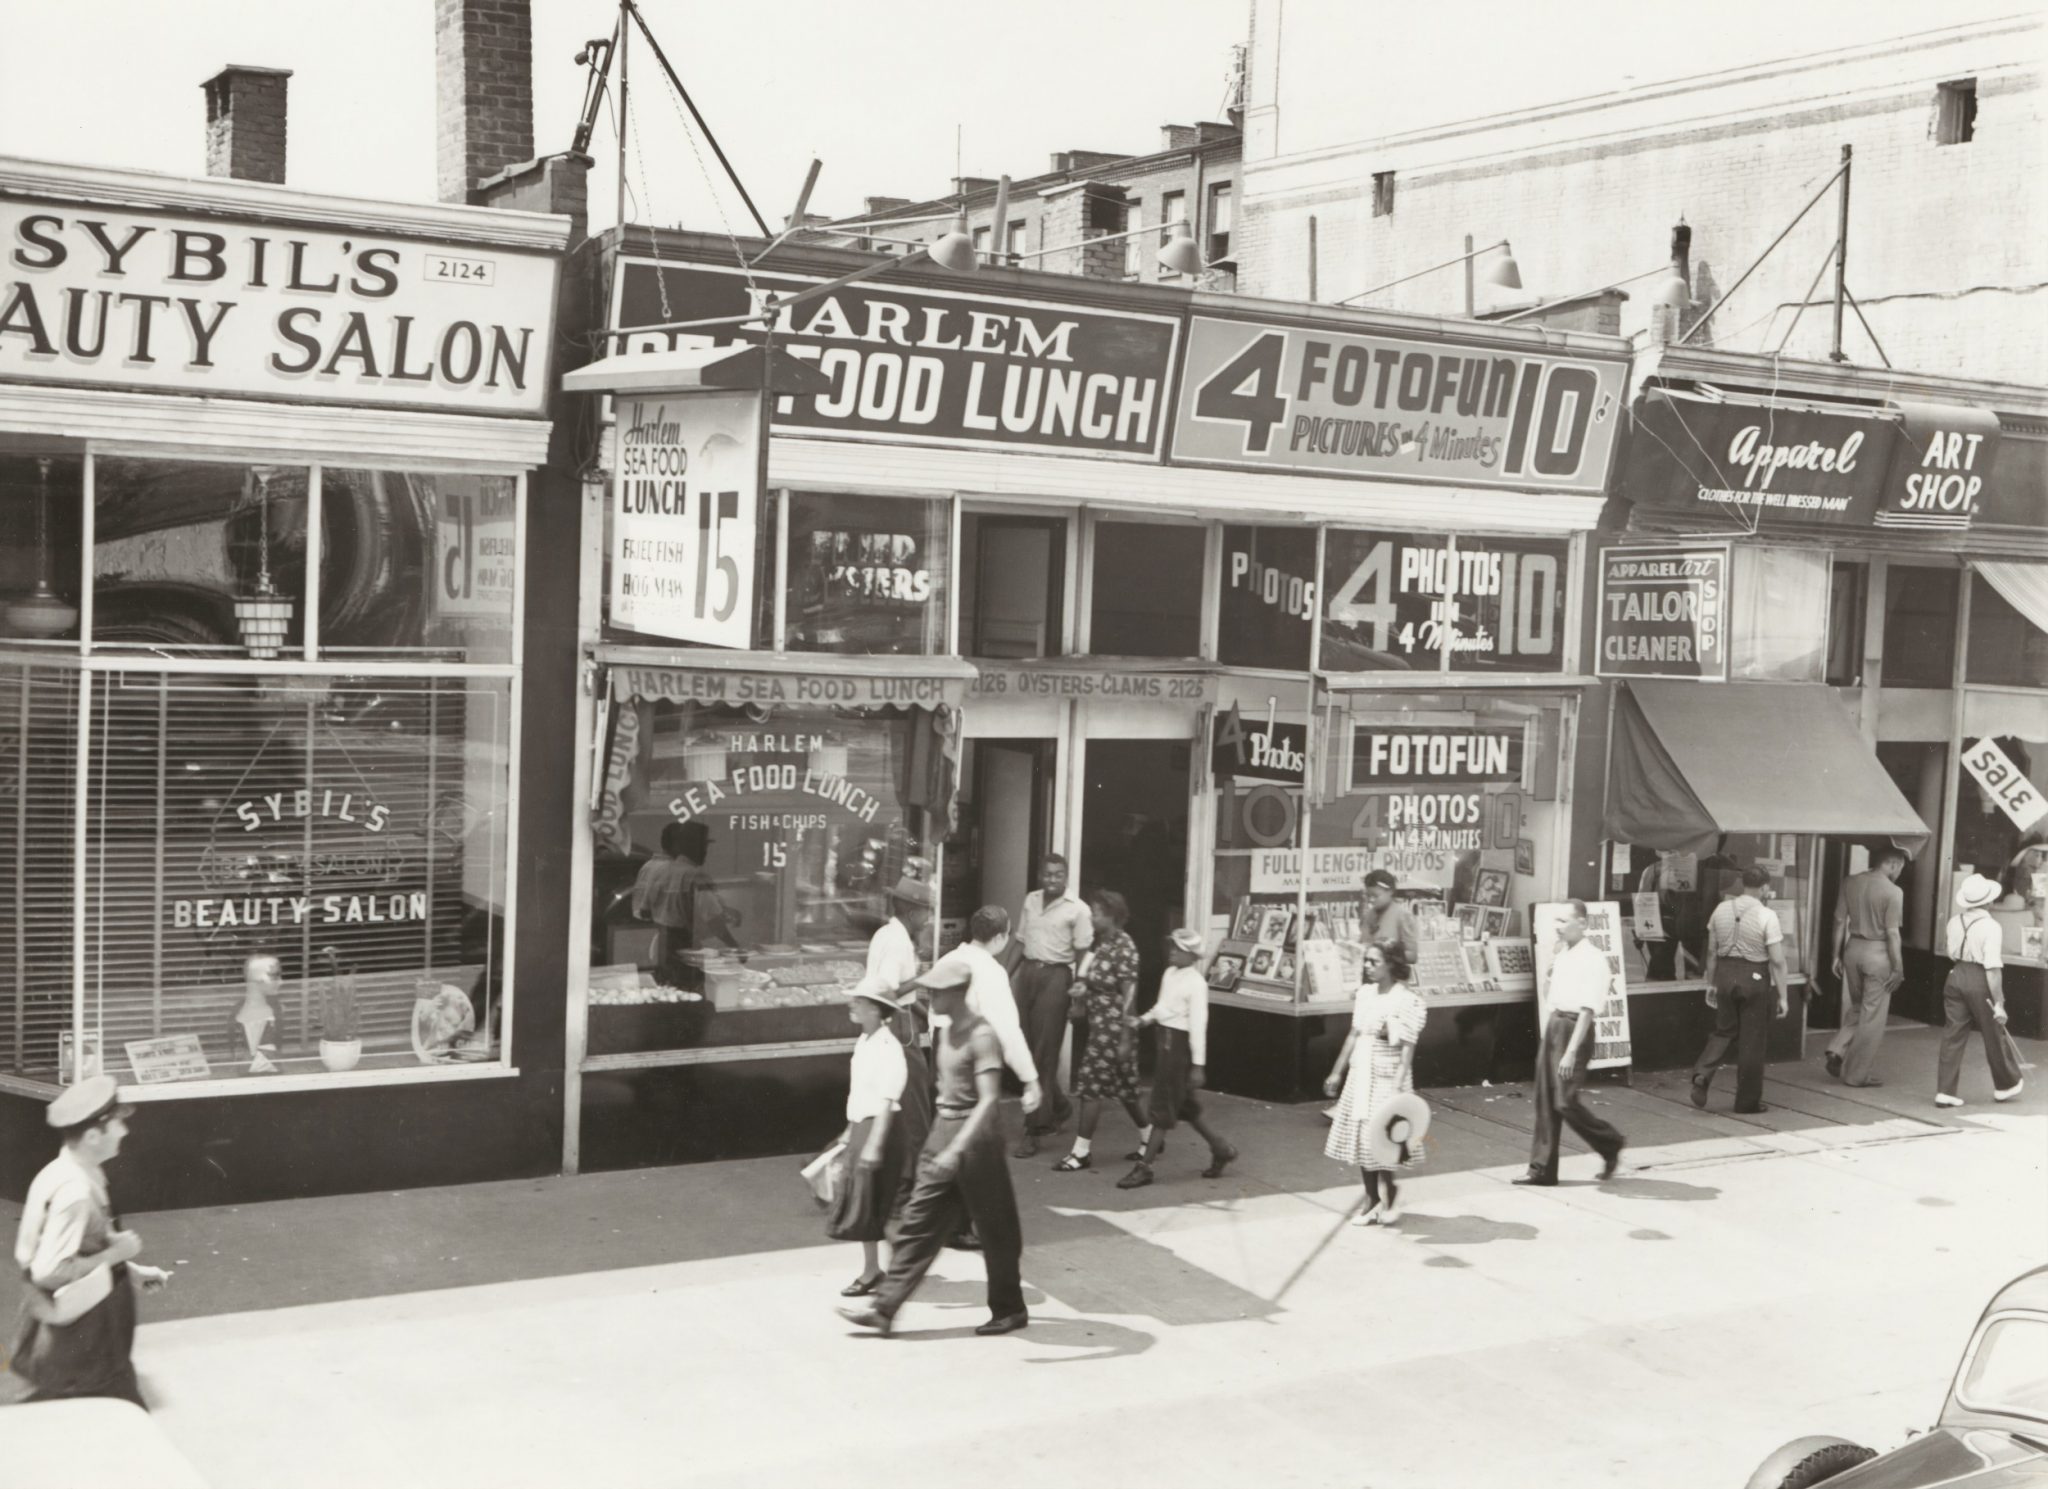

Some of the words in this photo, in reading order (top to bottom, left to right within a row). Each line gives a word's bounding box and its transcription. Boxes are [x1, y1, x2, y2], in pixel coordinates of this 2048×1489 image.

[11, 214, 401, 299] SYBIL'S
[438, 261, 486, 280] 2124
[739, 287, 1079, 362] HARLEM
[268, 307, 534, 391] SALON
[777, 344, 944, 426] OOD
[962, 361, 1157, 443] LUNCH
[1191, 328, 1291, 457] 4
[623, 402, 684, 446] Harlem
[1290, 414, 1401, 457] PICTURES
[1414, 420, 1429, 462] 4
[1429, 425, 1501, 468] Minutes
[624, 447, 649, 475] SEA
[651, 447, 688, 476] FOOD
[1727, 426, 1864, 489] Apparel
[1921, 430, 1983, 470] ART
[622, 480, 686, 515] LUNCH
[1900, 473, 1981, 511] SHOP
[694, 491, 739, 622] 15
[1607, 562, 1678, 578] APPAREL
[1329, 541, 1398, 652] 4
[1400, 547, 1501, 595] PHOTOS
[1607, 591, 1699, 622] TAILOR
[1399, 623, 1415, 653] 4
[1605, 635, 1693, 662] CLEANER
[626, 670, 727, 698] HARLEM
[737, 675, 786, 700] SEA
[796, 677, 857, 699] FOOD
[870, 678, 945, 699] LUNCH
[731, 734, 823, 753] HARLEM
[1370, 735, 1509, 775] FOTOFUN
[237, 790, 390, 831] SYBIL'S
[669, 780, 726, 824] SEA
[732, 764, 796, 795] FOOD
[802, 768, 880, 823] LUNCH
[1388, 794, 1480, 826] PHOTOS
[1388, 830, 1405, 851] IN
[1407, 828, 1420, 853] 4
[1422, 829, 1482, 850] MINUTES
[1263, 854, 1301, 875] FULL
[1313, 852, 1374, 873] LENGTH
[1383, 851, 1446, 872] PHOTOS
[174, 896, 307, 927] BEAUTY
[323, 894, 426, 922] SALON
